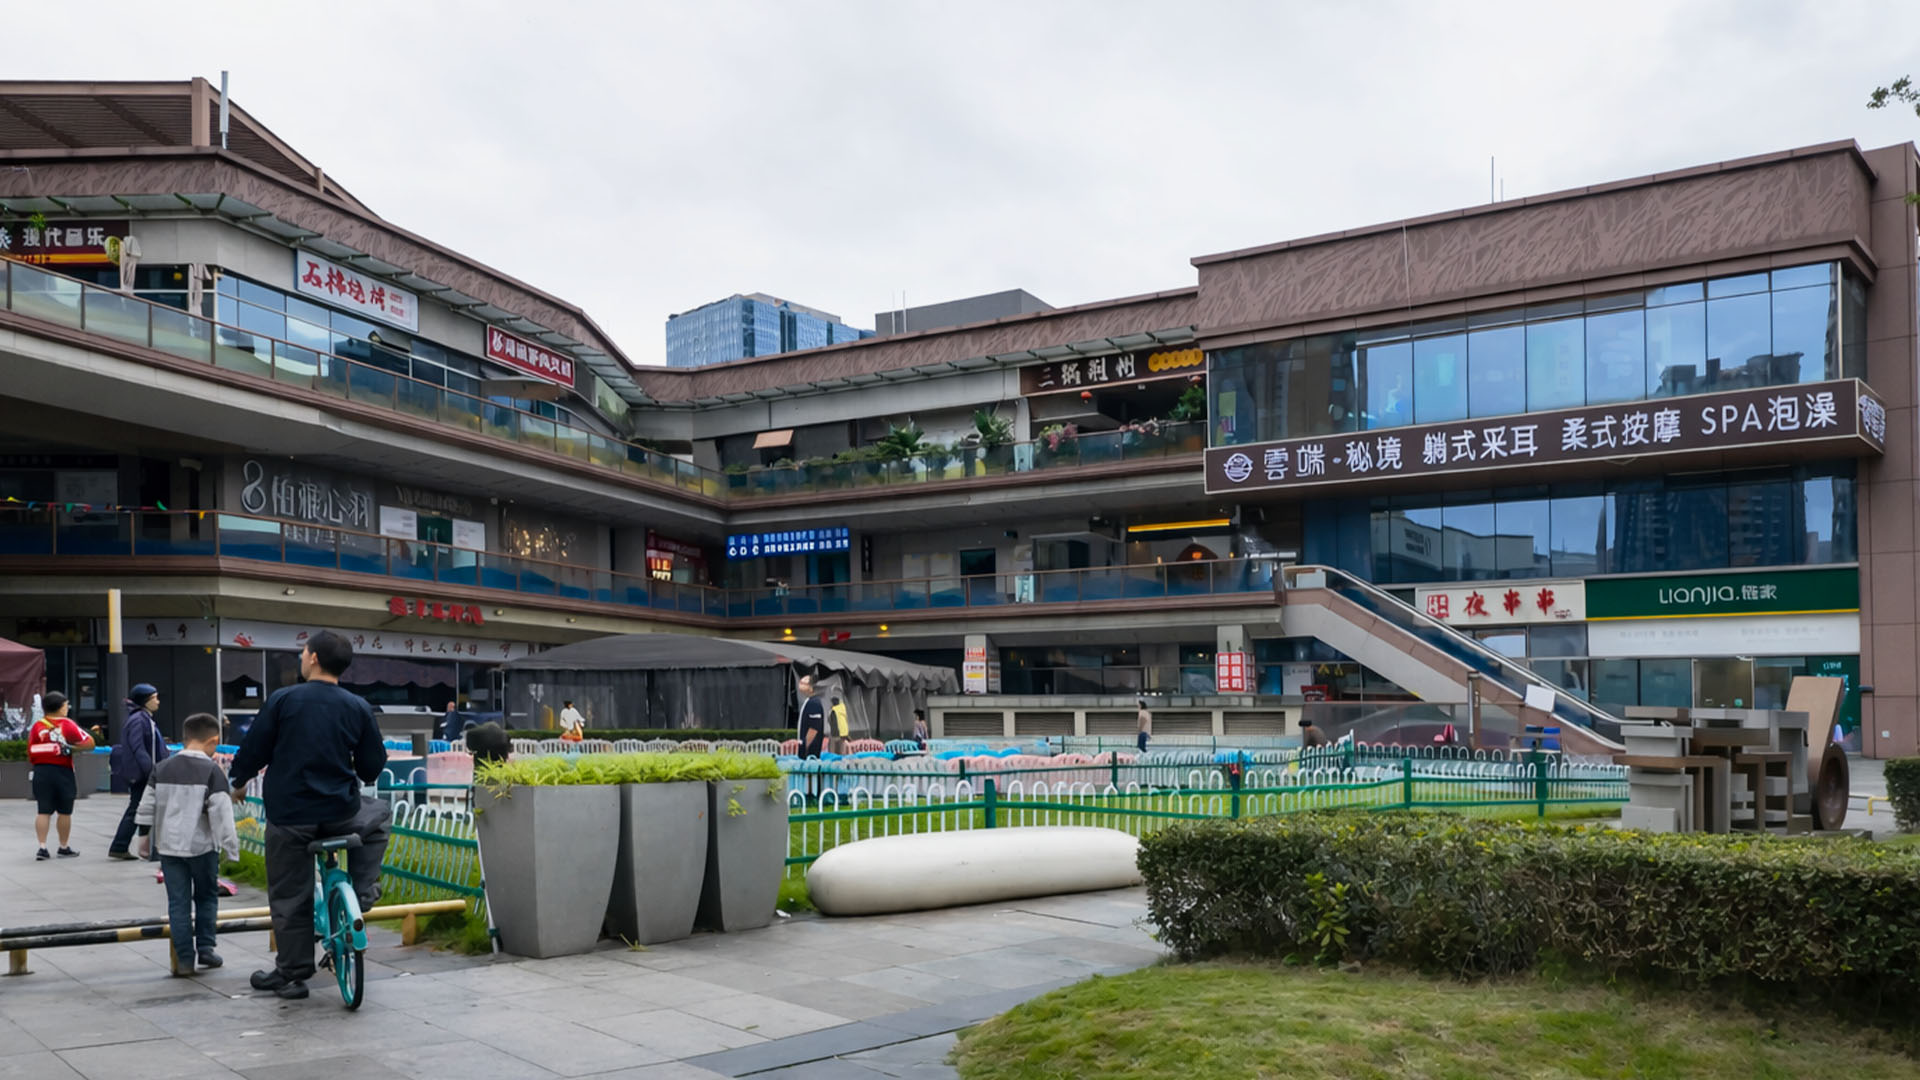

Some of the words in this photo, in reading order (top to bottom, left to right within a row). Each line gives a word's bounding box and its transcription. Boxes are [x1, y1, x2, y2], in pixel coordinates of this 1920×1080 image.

[1422, 424, 1539, 465] 躺式采耳
[1561, 407, 1682, 452] 柔式按摩
